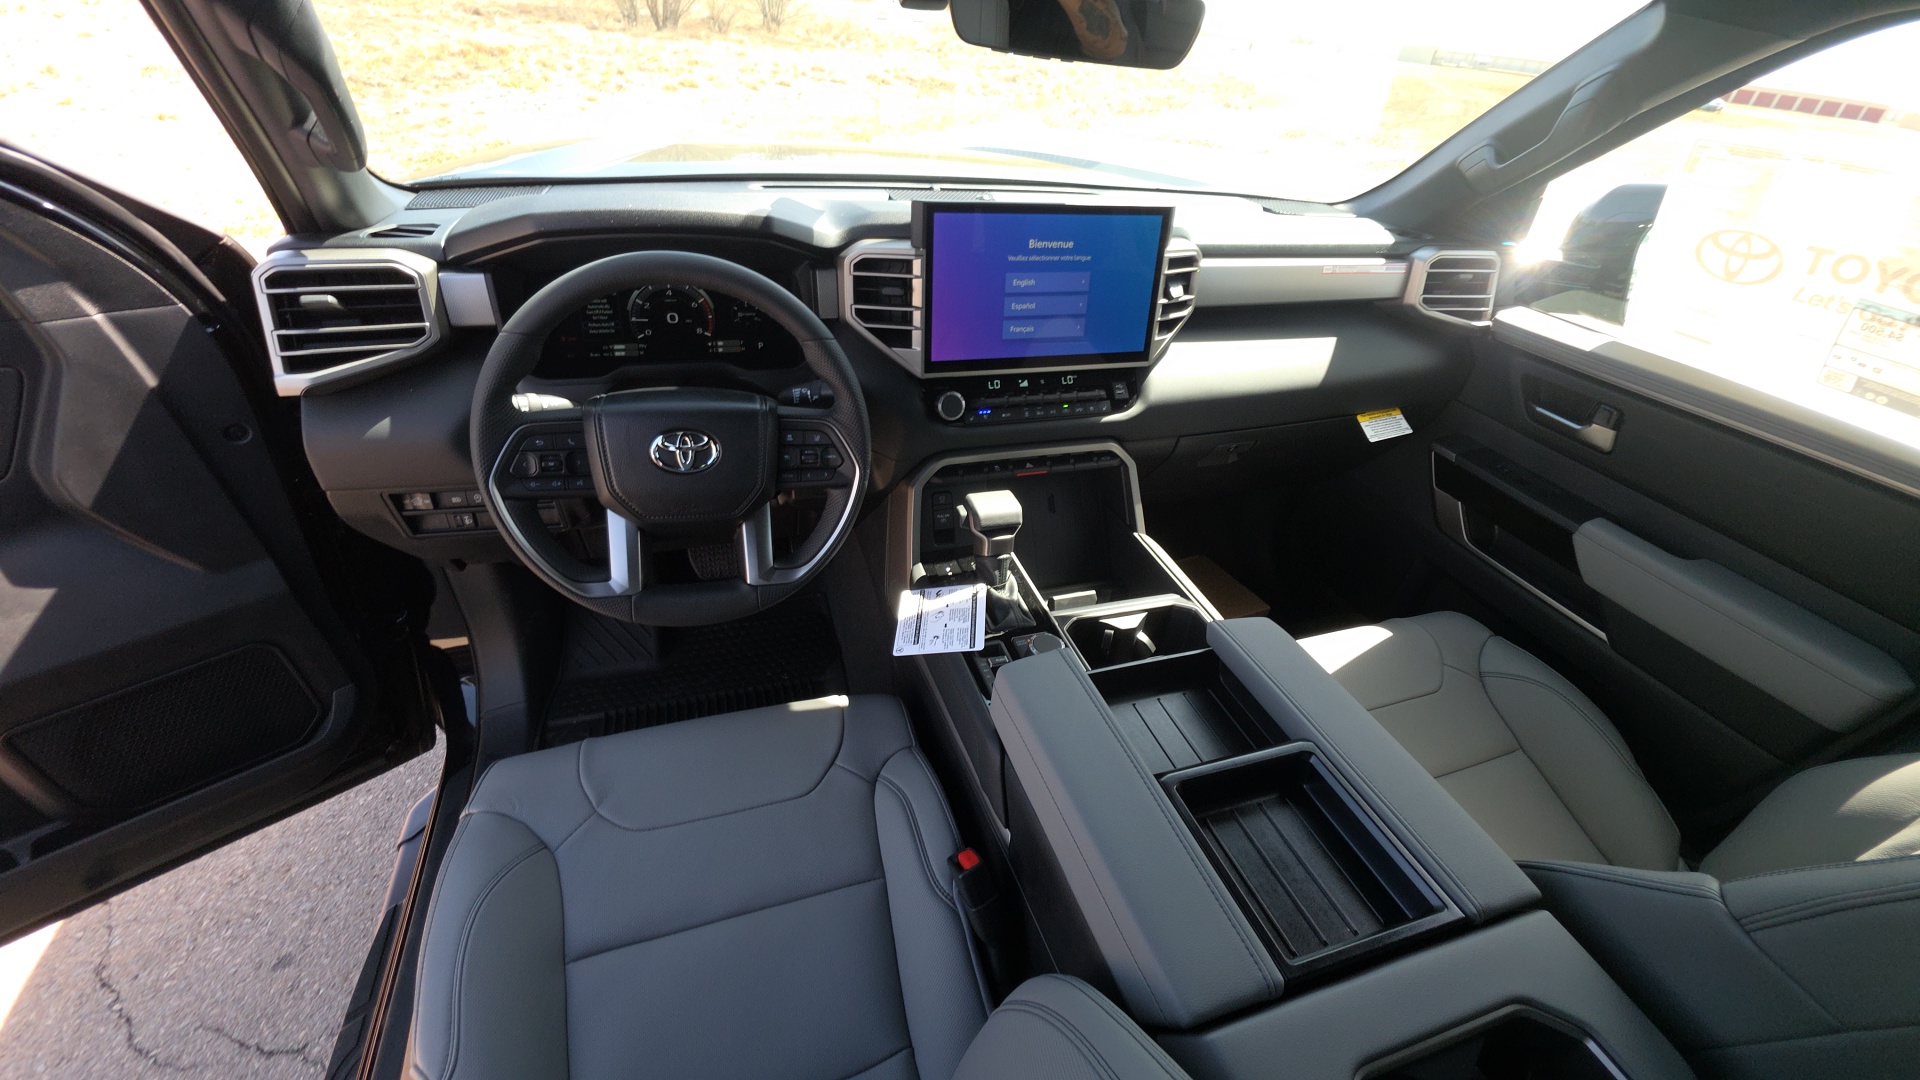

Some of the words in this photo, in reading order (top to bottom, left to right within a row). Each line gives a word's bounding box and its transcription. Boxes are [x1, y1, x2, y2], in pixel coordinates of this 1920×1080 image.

[1028, 239, 1074, 249] Bienvenue
[1013, 279, 1035, 287] English
[1792, 286, 1852, 315] Let's
[1011, 302, 1036, 311] Español
[666, 312, 679, 324] 0
[1010, 325, 1034, 334] Français
[988, 379, 1000, 390] LO
[1061, 375, 1073, 385] LO
